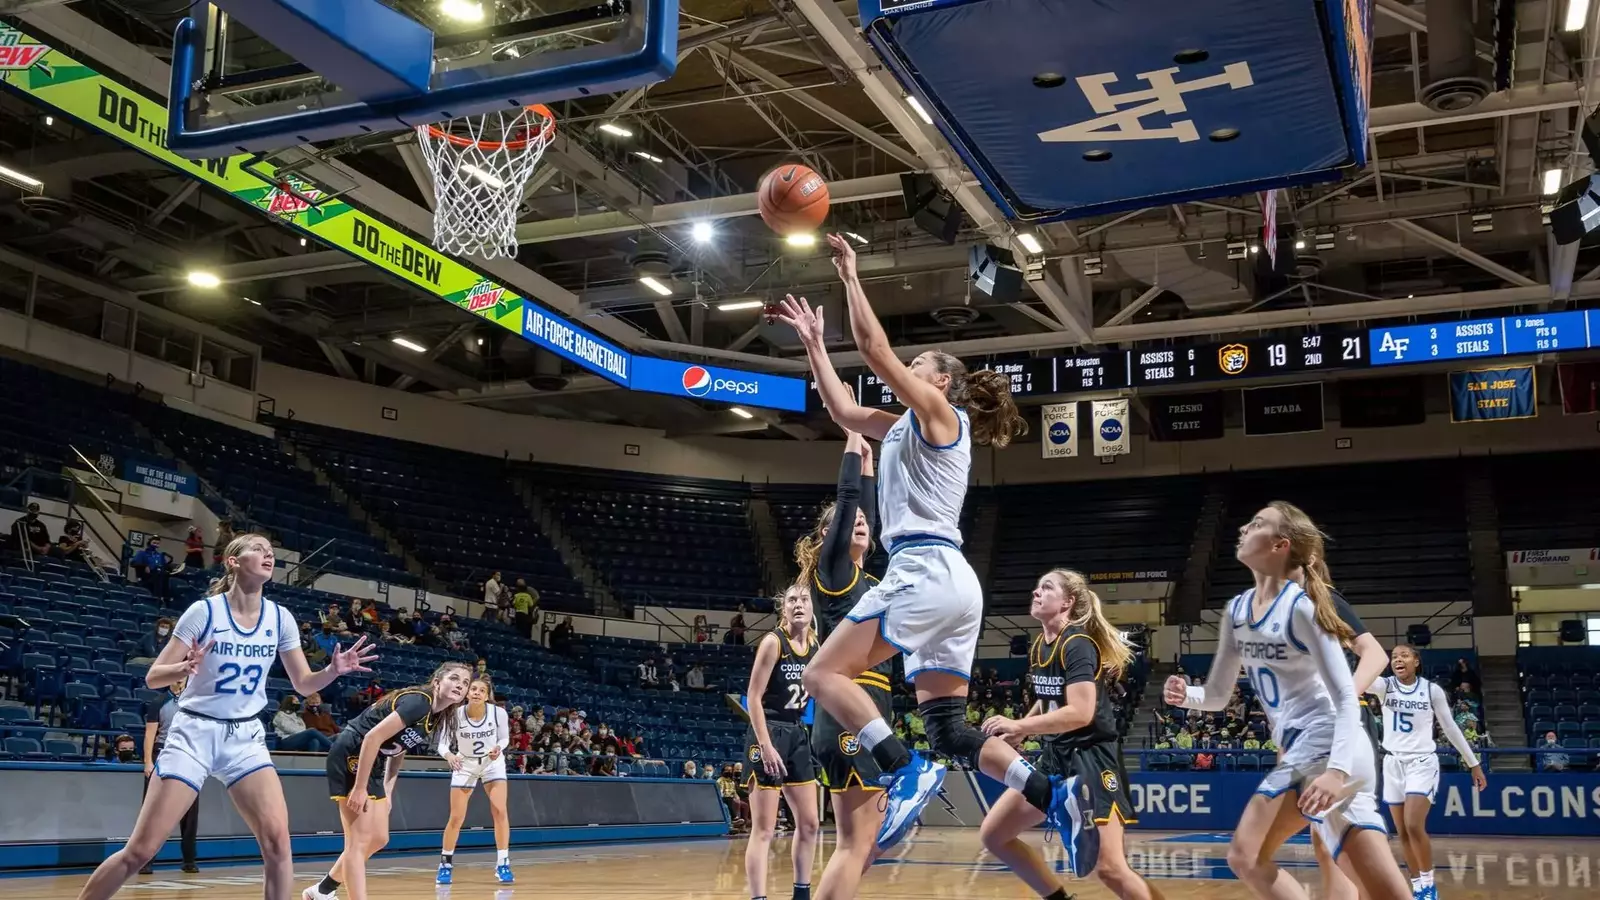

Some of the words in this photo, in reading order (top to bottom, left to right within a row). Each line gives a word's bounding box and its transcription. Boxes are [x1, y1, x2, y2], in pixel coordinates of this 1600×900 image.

[884, 2, 933, 15] DAKTRONICS
[98, 84, 139, 134] DO
[353, 216, 379, 253] DO
[380, 240, 401, 266] THE
[1515, 319, 1521, 328] 0
[1524, 318, 1544, 328] Jones
[1430, 328, 1437, 339] 3
[1455, 322, 1494, 337] ASSISTS
[1536, 328, 1549, 337] PTS
[1551, 327, 1557, 336] 0
[526, 308, 543, 338] AIR
[544, 317, 574, 353] FORCE
[575, 333, 628, 380] BASKETBALL
[1302, 336, 1321, 349] 5:47
[1378, 331, 1410, 360] AF
[1431, 344, 1438, 356] 3
[1456, 340, 1490, 354] STEALS
[1536, 340, 1549, 350] FLS
[1552, 338, 1558, 348] 0
[1342, 337, 1361, 360] 21
[1140, 351, 1174, 365] ASSISTS
[1188, 350, 1194, 360] 6
[1267, 344, 1286, 367] 19
[1304, 353, 1322, 366] 2ND
[1065, 359, 1073, 368] 34
[995, 365, 1003, 374] 33
[1082, 368, 1094, 377] PTS
[1098, 367, 1104, 376] 0
[1145, 366, 1174, 380] STEALS
[1189, 365, 1194, 376] 1
[867, 376, 875, 385] 22
[1011, 374, 1023, 383] PTS
[1026, 373, 1032, 381] 7
[1082, 378, 1093, 387] FLS
[1099, 377, 1103, 386] 1
[714, 378, 758, 395] pepsi
[1011, 384, 1022, 393] FLS
[1026, 383, 1032, 392] 0
[1467, 381, 1487, 392] SAN
[1490, 379, 1516, 390] JOSE
[881, 395, 892, 403] FLS
[1477, 398, 1509, 409] STATE
[1050, 405, 1067, 413] AIR
[1168, 403, 1203, 414] FRESNO
[1264, 404, 1302, 415] NEVADA
[1043, 411, 1075, 420] FORCE
[1101, 426, 1122, 435] NCAA
[1171, 420, 1201, 430] STATE
[1049, 429, 1070, 438] NCAA
[1050, 447, 1072, 456] 1960
[1102, 444, 1124, 453] 1962
[1526, 555, 1570, 563] COMMAND
[1135, 571, 1146, 579] AIR
[1146, 570, 1168, 578] FORCE
[211, 640, 234, 656] AIR
[235, 644, 276, 658] FORCE
[1244, 641, 1288, 660] FORCE
[780, 663, 806, 672] COLOR
[215, 662, 263, 695] 23
[1385, 698, 1399, 708] AIR
[1399, 700, 1429, 711] FORCE
[1392, 710, 1415, 733] 15
[471, 729, 496, 739] FORCE
[472, 741, 485, 755] 2
[1129, 783, 1211, 814] ORCE
[1443, 785, 1600, 818] ALCON
